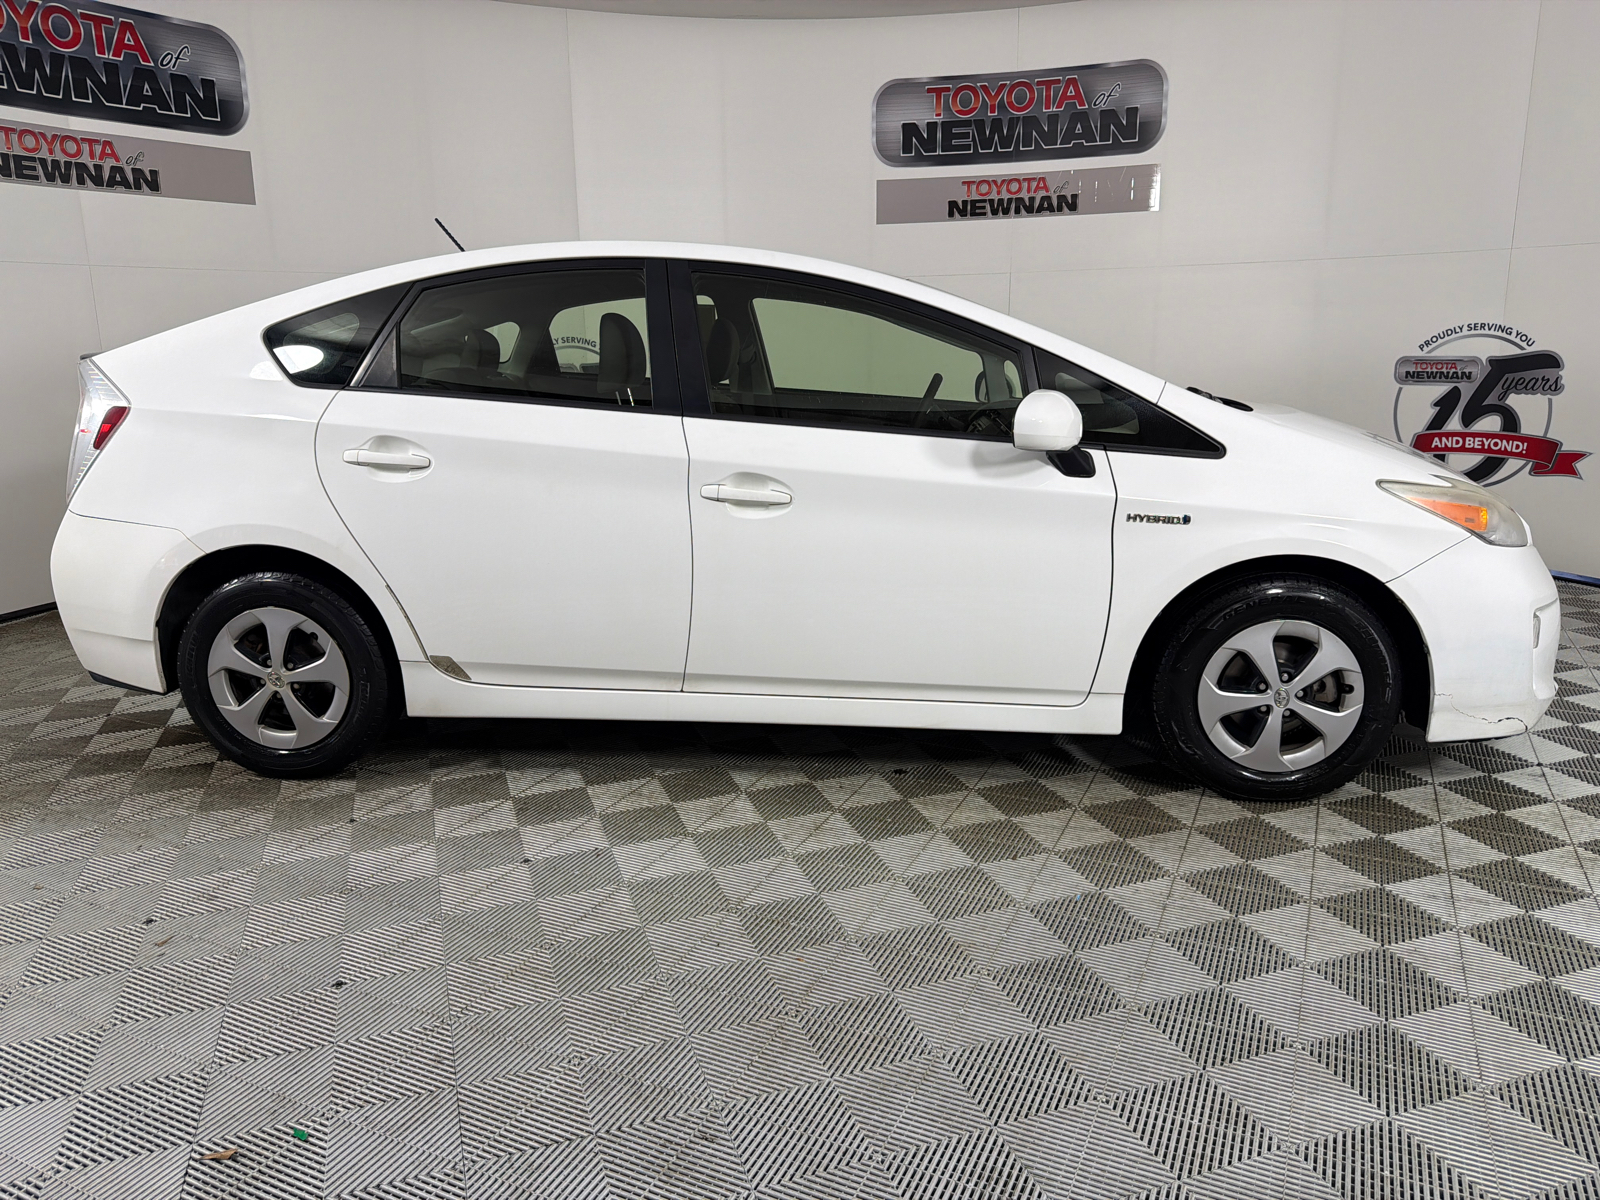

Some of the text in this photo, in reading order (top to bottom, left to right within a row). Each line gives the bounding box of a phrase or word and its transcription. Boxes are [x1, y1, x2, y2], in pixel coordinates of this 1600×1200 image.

[0, 0, 190, 70] YOTA of
[0, 41, 221, 121] WNAN
[925, 75, 1121, 119] TOYOTA of
[901, 105, 1140, 157] NEWNAN
[0, 125, 144, 166] TOYOTA of
[962, 176, 1069, 198] TOYOTA of
[947, 193, 1078, 219] NEWNAN
[561, 336, 597, 348] SERVING
[1418, 322, 1536, 352] PROUDLY SERVING YOU
[1404, 370, 1473, 381] NEWNAN
[1412, 361, 1458, 371] TOYOTA
[1498, 375, 1562, 402] years
[1431, 436, 1528, 454] AND BEYOND!
[1126, 513, 1181, 525] HYBRID
